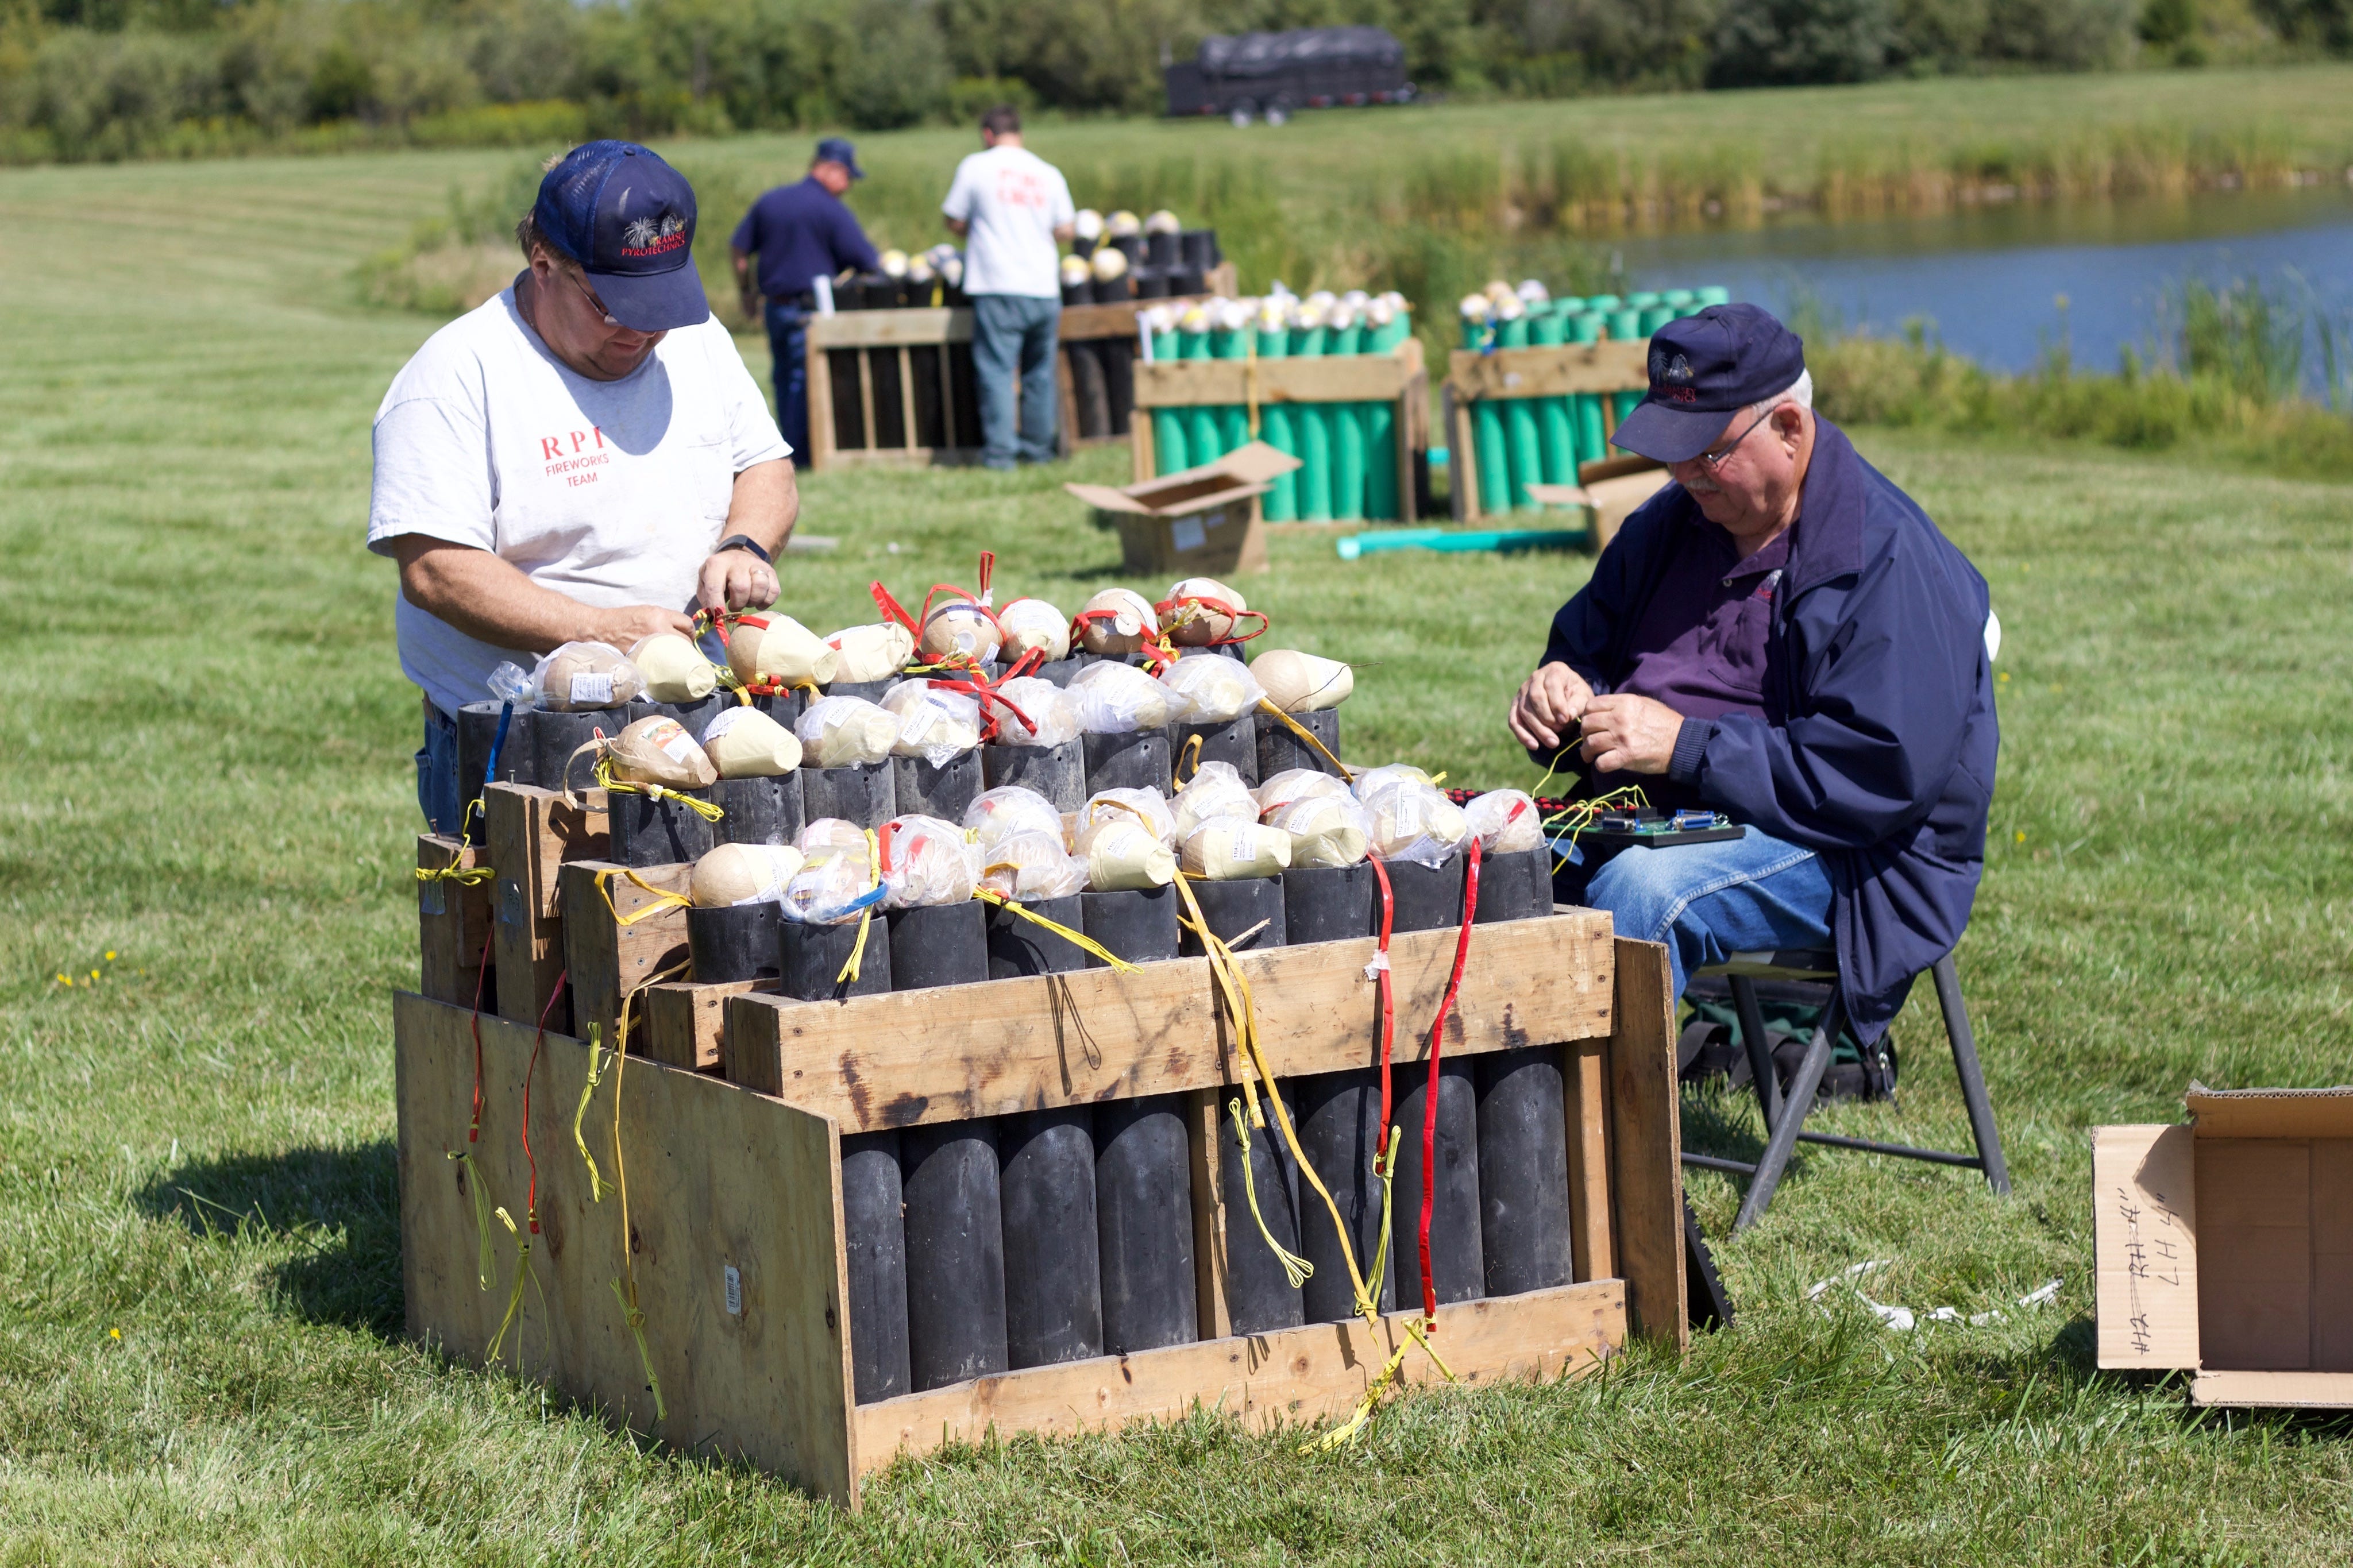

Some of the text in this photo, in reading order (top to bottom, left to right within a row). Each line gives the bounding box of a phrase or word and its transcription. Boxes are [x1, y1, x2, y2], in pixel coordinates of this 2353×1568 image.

[656, 230, 685, 245] RAMSEY
[622, 240, 685, 256] PYROTECHNICS
[546, 453, 609, 477] FIREWORKS
[566, 472, 598, 488] TEAM
